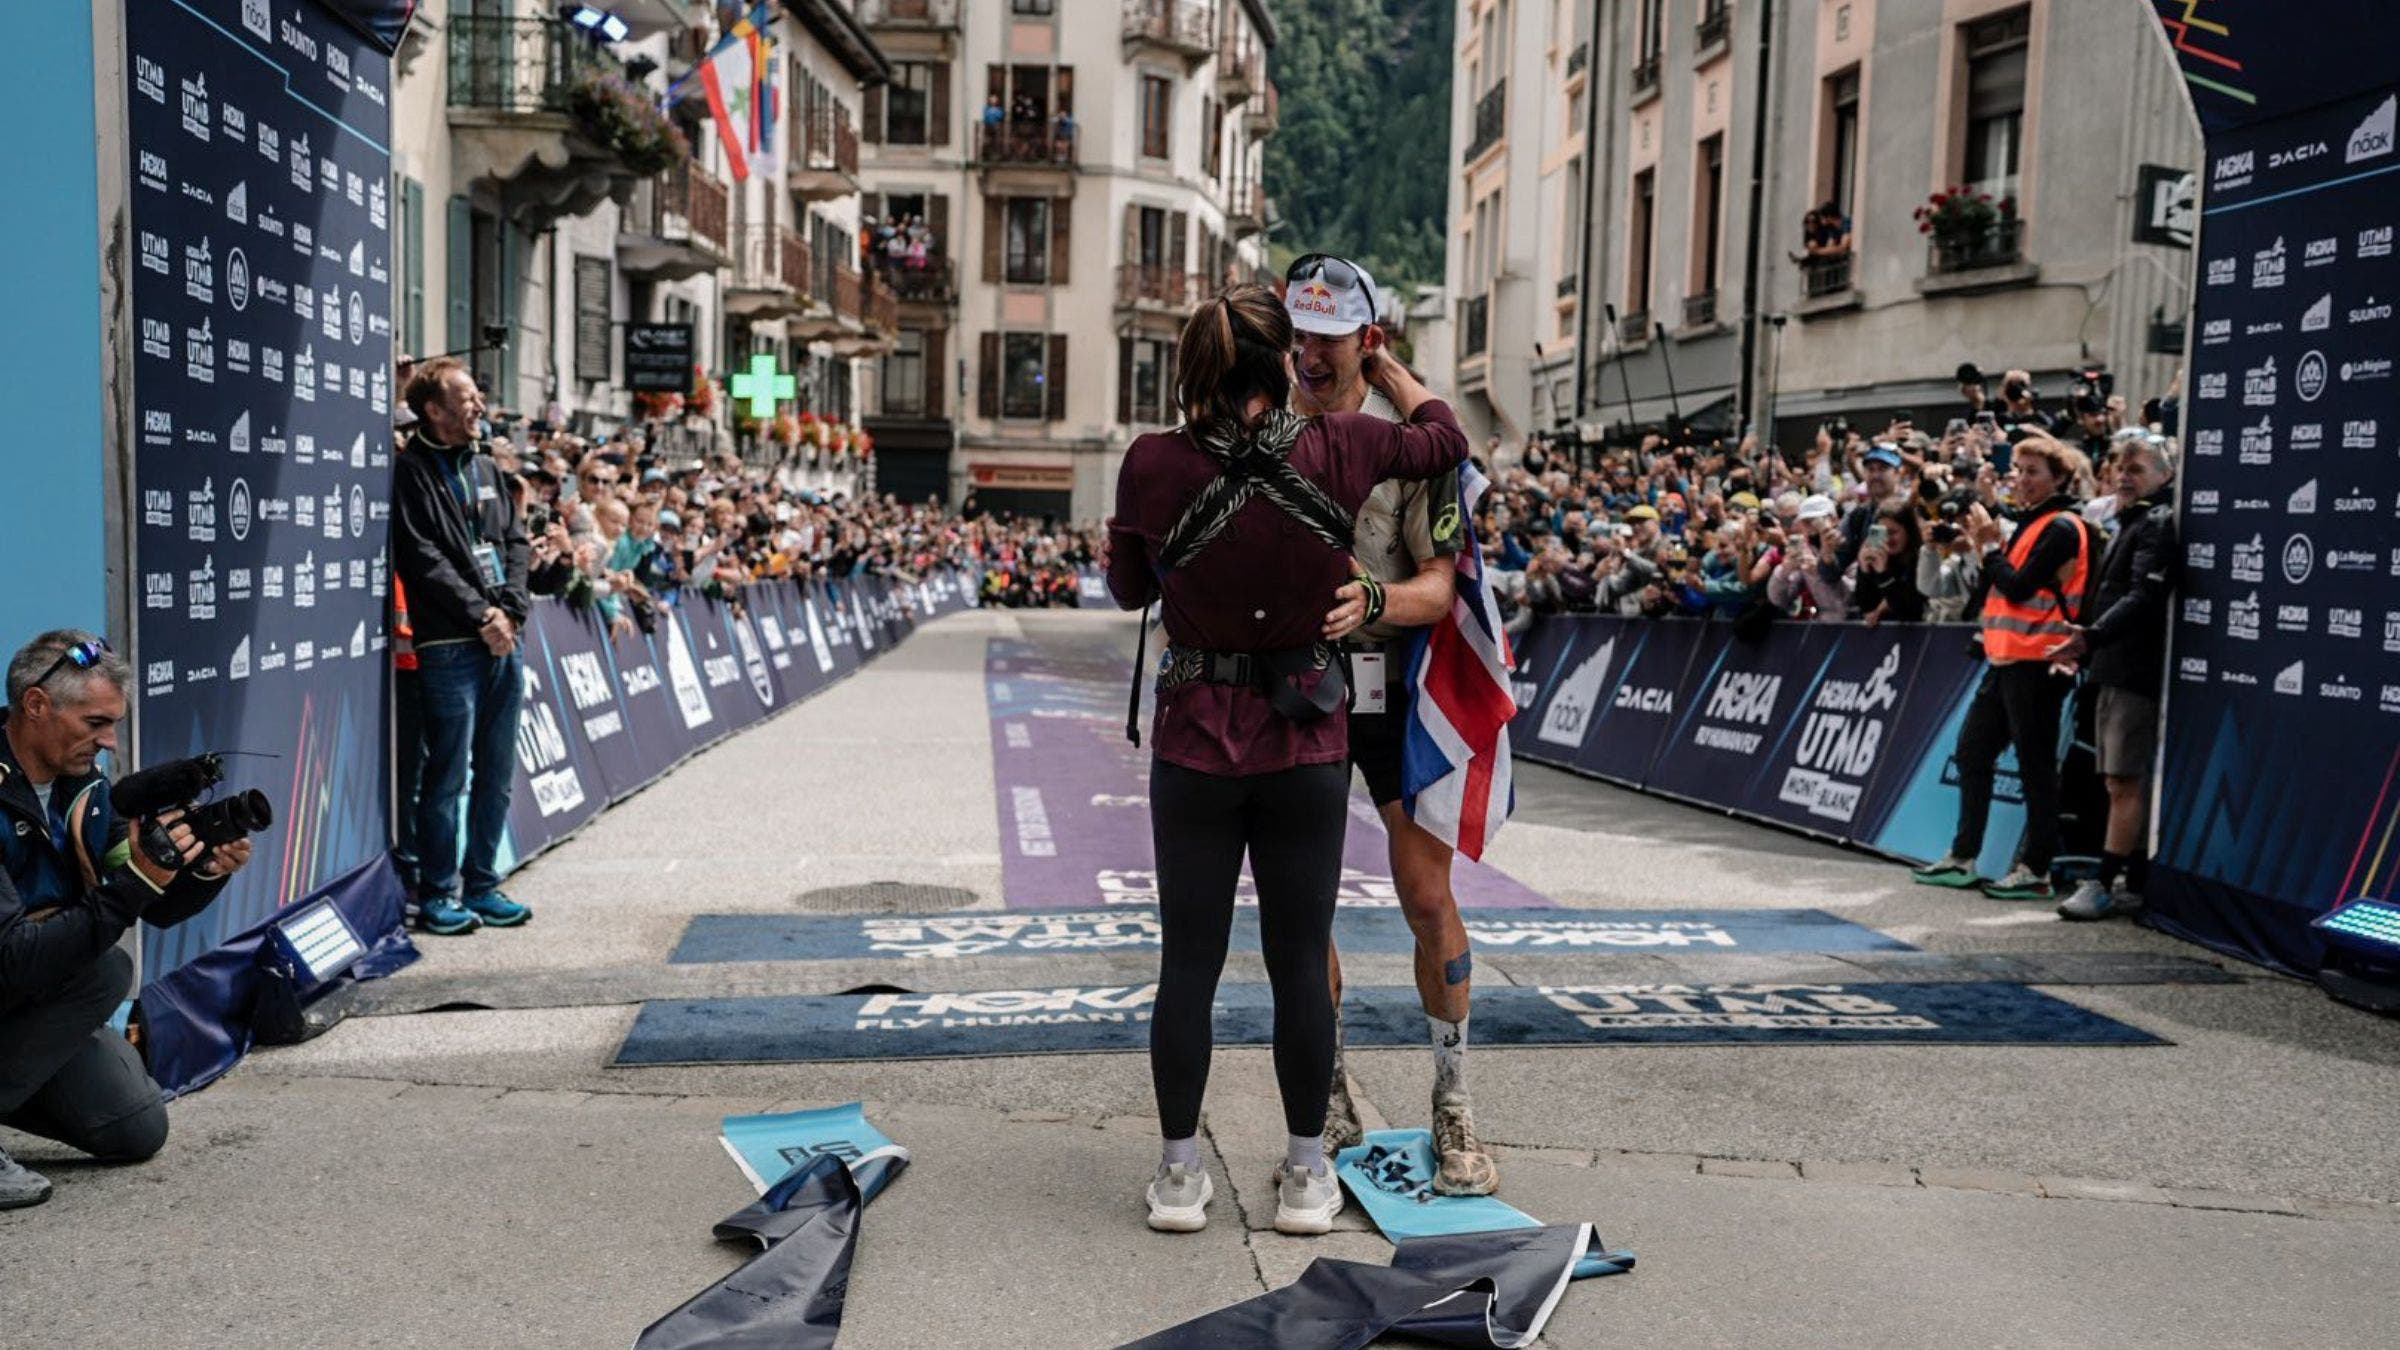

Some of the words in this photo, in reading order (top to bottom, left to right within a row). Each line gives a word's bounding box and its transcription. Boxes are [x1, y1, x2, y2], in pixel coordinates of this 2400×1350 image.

[281, 19, 317, 62] SUUNTO
[136, 54, 165, 88] UTMB
[326, 42, 350, 80] HOKA
[182, 91, 209, 125] UTMB
[140, 149, 167, 181] HOKA
[2214, 150, 2255, 181] HOKA
[2268, 141, 2329, 169] DACIA
[182, 181, 213, 205] DACIA
[141, 231, 169, 259] UTMB
[2358, 226, 2393, 247] UTMB
[2304, 237, 2337, 260] HOKA
[186, 258, 213, 288] UTMB
[2253, 256, 2286, 278] UTMB
[1293, 299, 1312, 310] Red
[1314, 301, 1336, 315] Bull
[2348, 304, 2392, 323] SUUNTO
[143, 318, 170, 344] UTMB
[187, 340, 214, 368] UTMB
[2244, 376, 2276, 394] UTMB
[145, 410, 172, 434] HOKA
[2291, 423, 2323, 442] HOKA
[2343, 419, 2377, 438] UTMB
[186, 429, 217, 444] DACIA
[2240, 435, 2272, 453] UTMB
[145, 490, 172, 511] UTMB
[2333, 498, 2376, 512] SUUNTO
[189, 503, 215, 526] UTMB
[2231, 553, 2264, 570] UTMB
[146, 572, 173, 594] UTMB
[190, 582, 215, 605] UTMB
[2228, 610, 2260, 628] UTMB
[2277, 605, 2309, 623] HOKA
[2329, 608, 2362, 626] UTMB
[2385, 622, 2400, 639] UT
[147, 659, 175, 685] HOKA
[187, 666, 218, 683] DACIA
[2181, 657, 2208, 674] HOKA
[560, 650, 613, 711] HOKA
[2320, 683, 2361, 700] SUUNTO
[1510, 681, 1538, 708] NTO
[1615, 684, 1674, 714] DACIA
[1705, 669, 1782, 726] HOKA
[1815, 679, 1861, 711] HOKA
[2380, 685, 2400, 703] HO
[1796, 711, 1883, 777] UTMB
[863, 921, 1160, 941] UTMB
[1465, 929, 1738, 947] HOKA
[1545, 993, 1898, 1014] UTMB
[857, 1019, 929, 1030] FLY
[942, 1010, 1126, 1028] HUMAN
